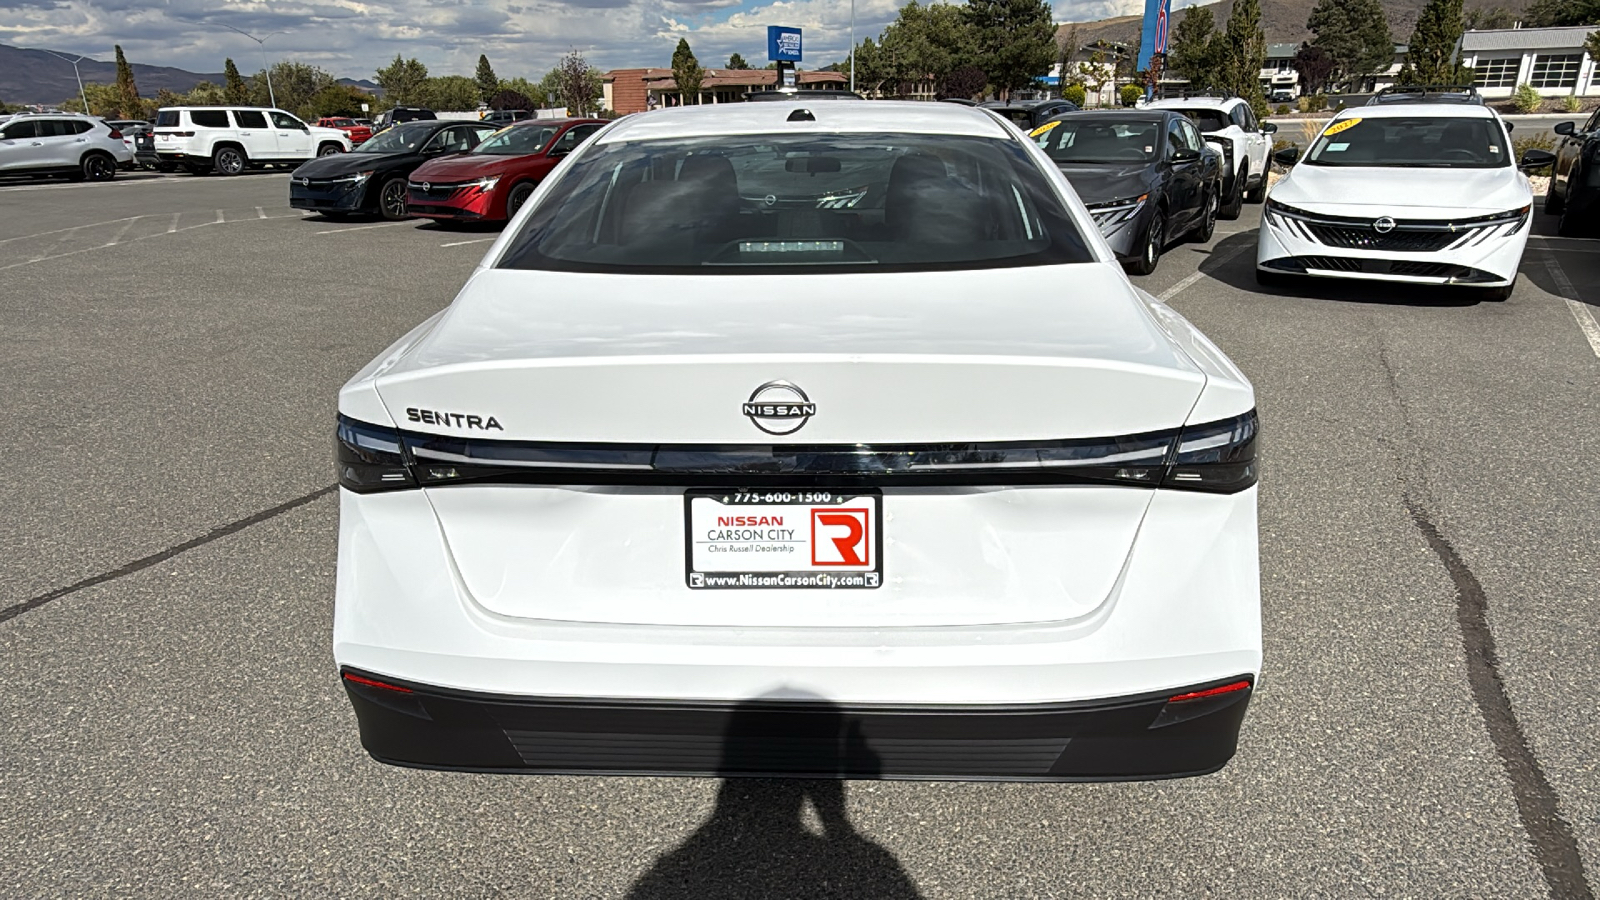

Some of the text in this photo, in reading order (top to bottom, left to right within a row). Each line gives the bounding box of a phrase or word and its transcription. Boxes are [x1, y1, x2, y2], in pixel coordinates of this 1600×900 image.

[744, 405, 814, 415] NISSAN
[406, 407, 504, 431] SENTRA
[734, 492, 831, 503] 775-600-1500
[717, 516, 784, 527] NISSAN
[707, 529, 795, 541] CARSON CITY
[708, 544, 795, 554] Chris Russell Dealership
[705, 573, 864, 589] www.NissanCarsonCity.com
